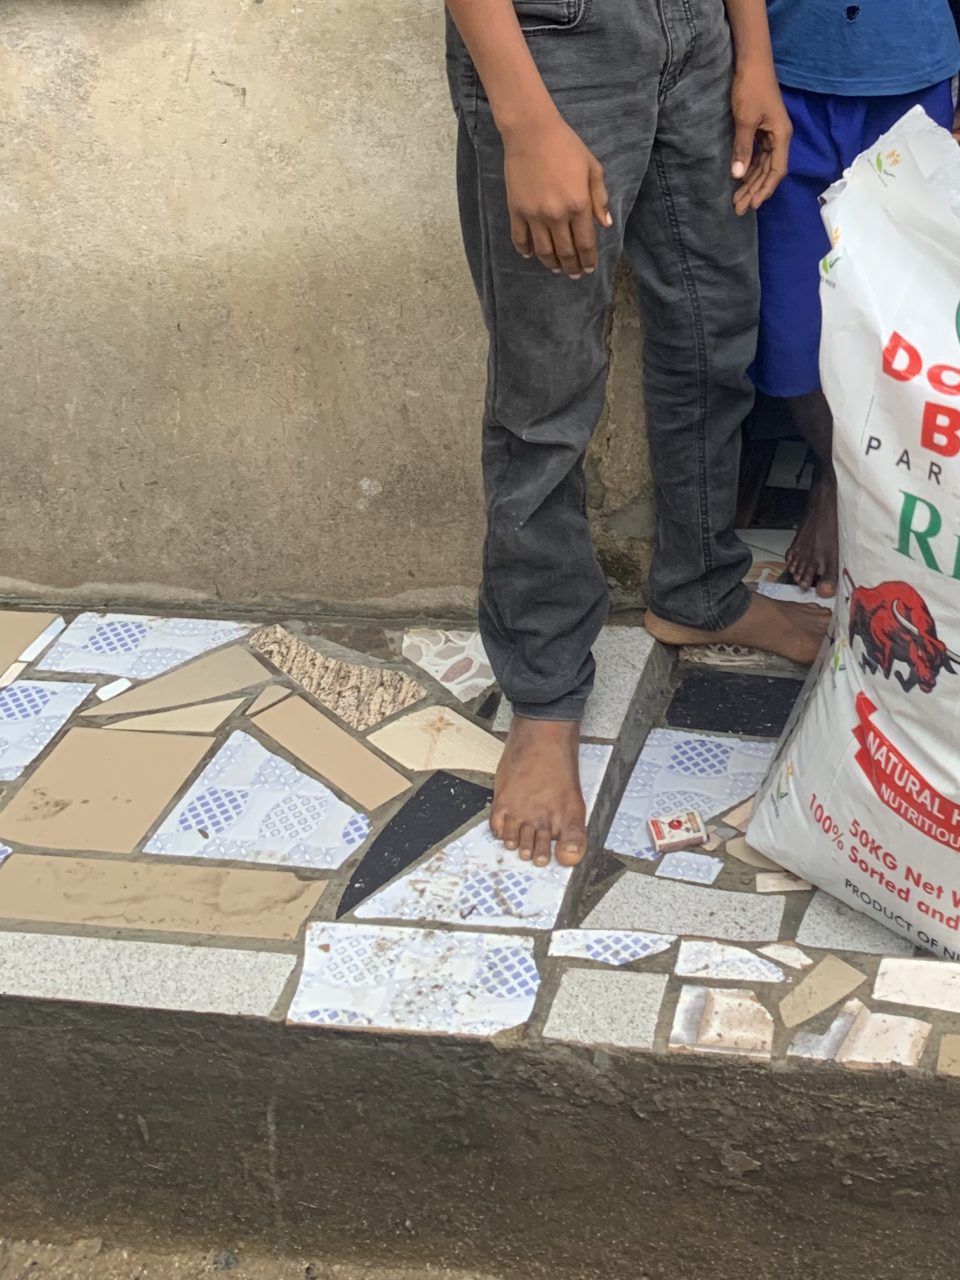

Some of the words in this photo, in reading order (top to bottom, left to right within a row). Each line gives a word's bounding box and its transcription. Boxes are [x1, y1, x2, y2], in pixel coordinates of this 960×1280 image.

[867, 730, 945, 820] NATURAL
[808, 793, 844, 851] 100%
[848, 846, 910, 903] Sorted
[917, 900, 960, 931] and
[849, 819, 898, 872] 50KG
[905, 866, 944, 899] Net
[845, 878, 913, 932] PRODUCT
[917, 930, 938, 948] OF
